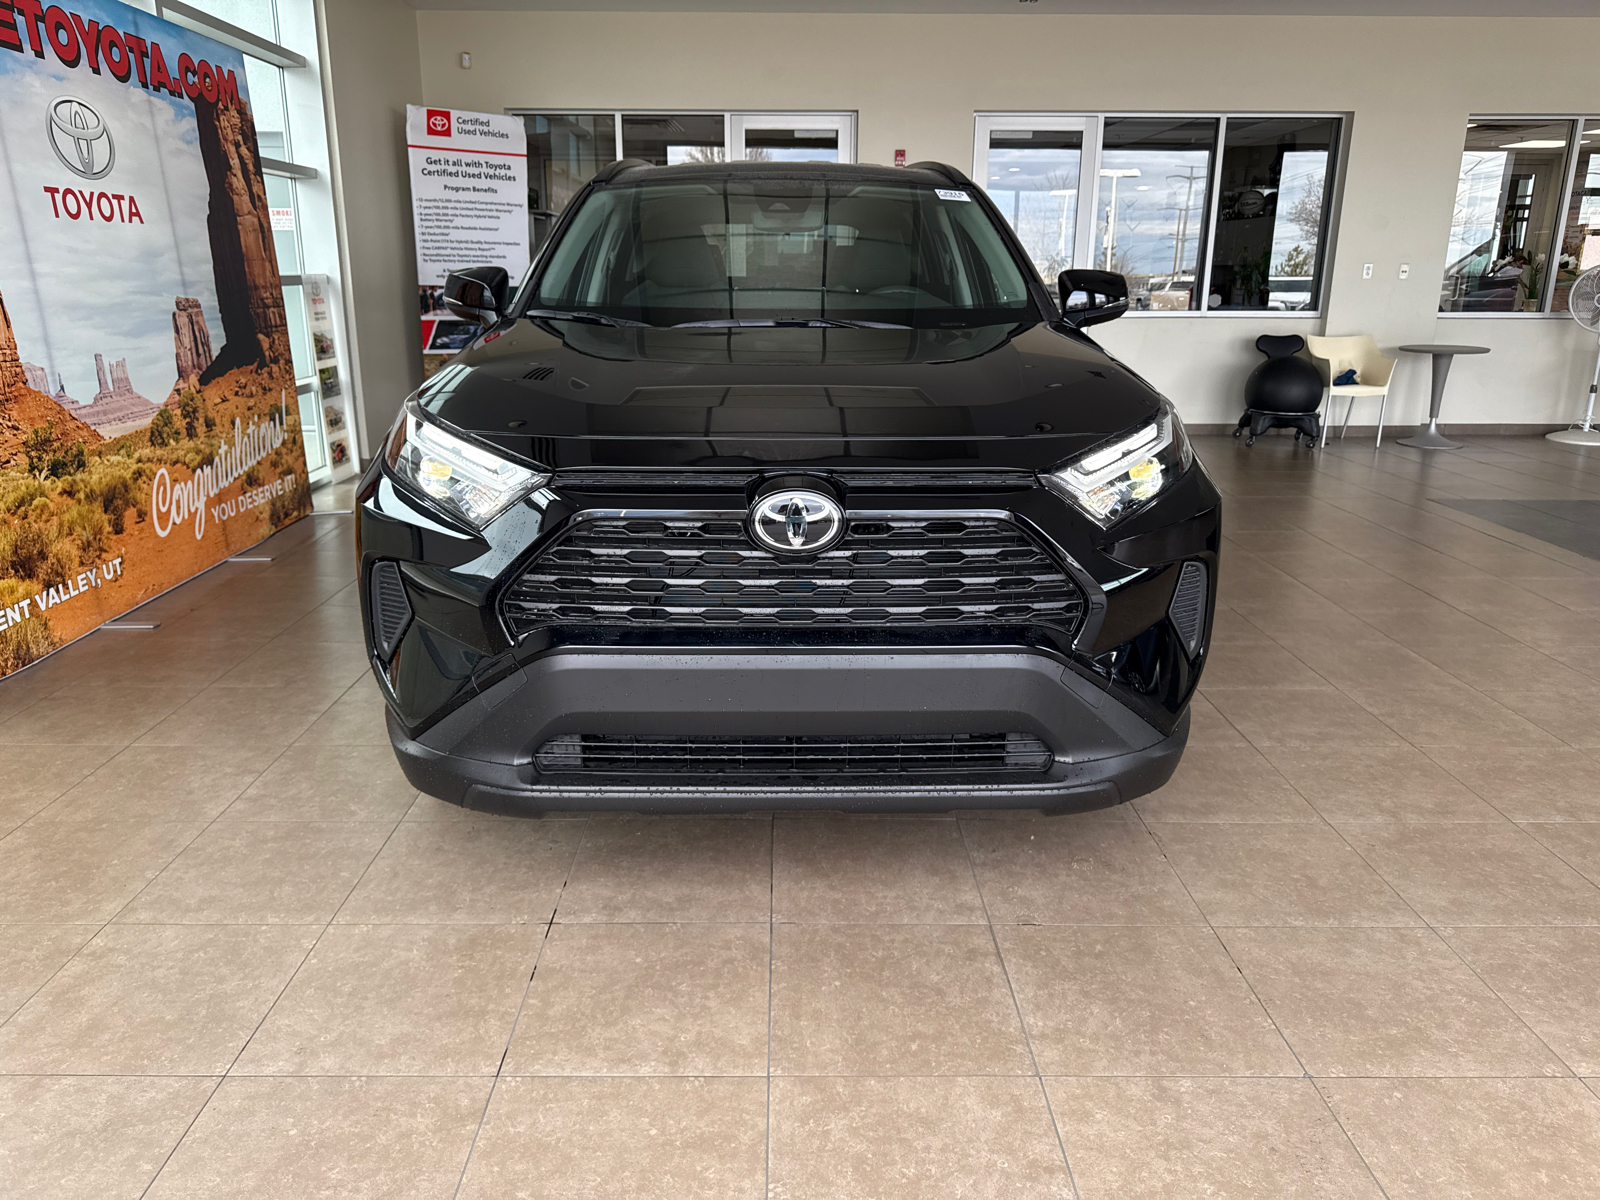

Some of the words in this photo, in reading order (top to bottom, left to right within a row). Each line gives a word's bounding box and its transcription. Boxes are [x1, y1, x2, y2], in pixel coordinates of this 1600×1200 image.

[456, 116, 490, 127] Certified
[457, 127, 476, 136] Used
[478, 128, 509, 139] Vehicles
[426, 157, 442, 166] Get
[444, 158, 450, 166] it
[452, 158, 463, 167] all
[464, 160, 483, 169] with
[484, 162, 511, 171] Toyota
[421, 168, 459, 178] Certified
[461, 170, 482, 179] Used
[483, 172, 516, 182] Vehicles
[444, 184, 471, 193] Program
[43, 186, 144, 224] TOYOTA
[152, 388, 288, 540] Congratulations!
[211, 500, 236, 524] YOU
[238, 480, 283, 512] DESERVE
[284, 474, 297, 492] IT!
[34, 568, 101, 612] VALLEY,
[102, 557, 122, 580] UT
